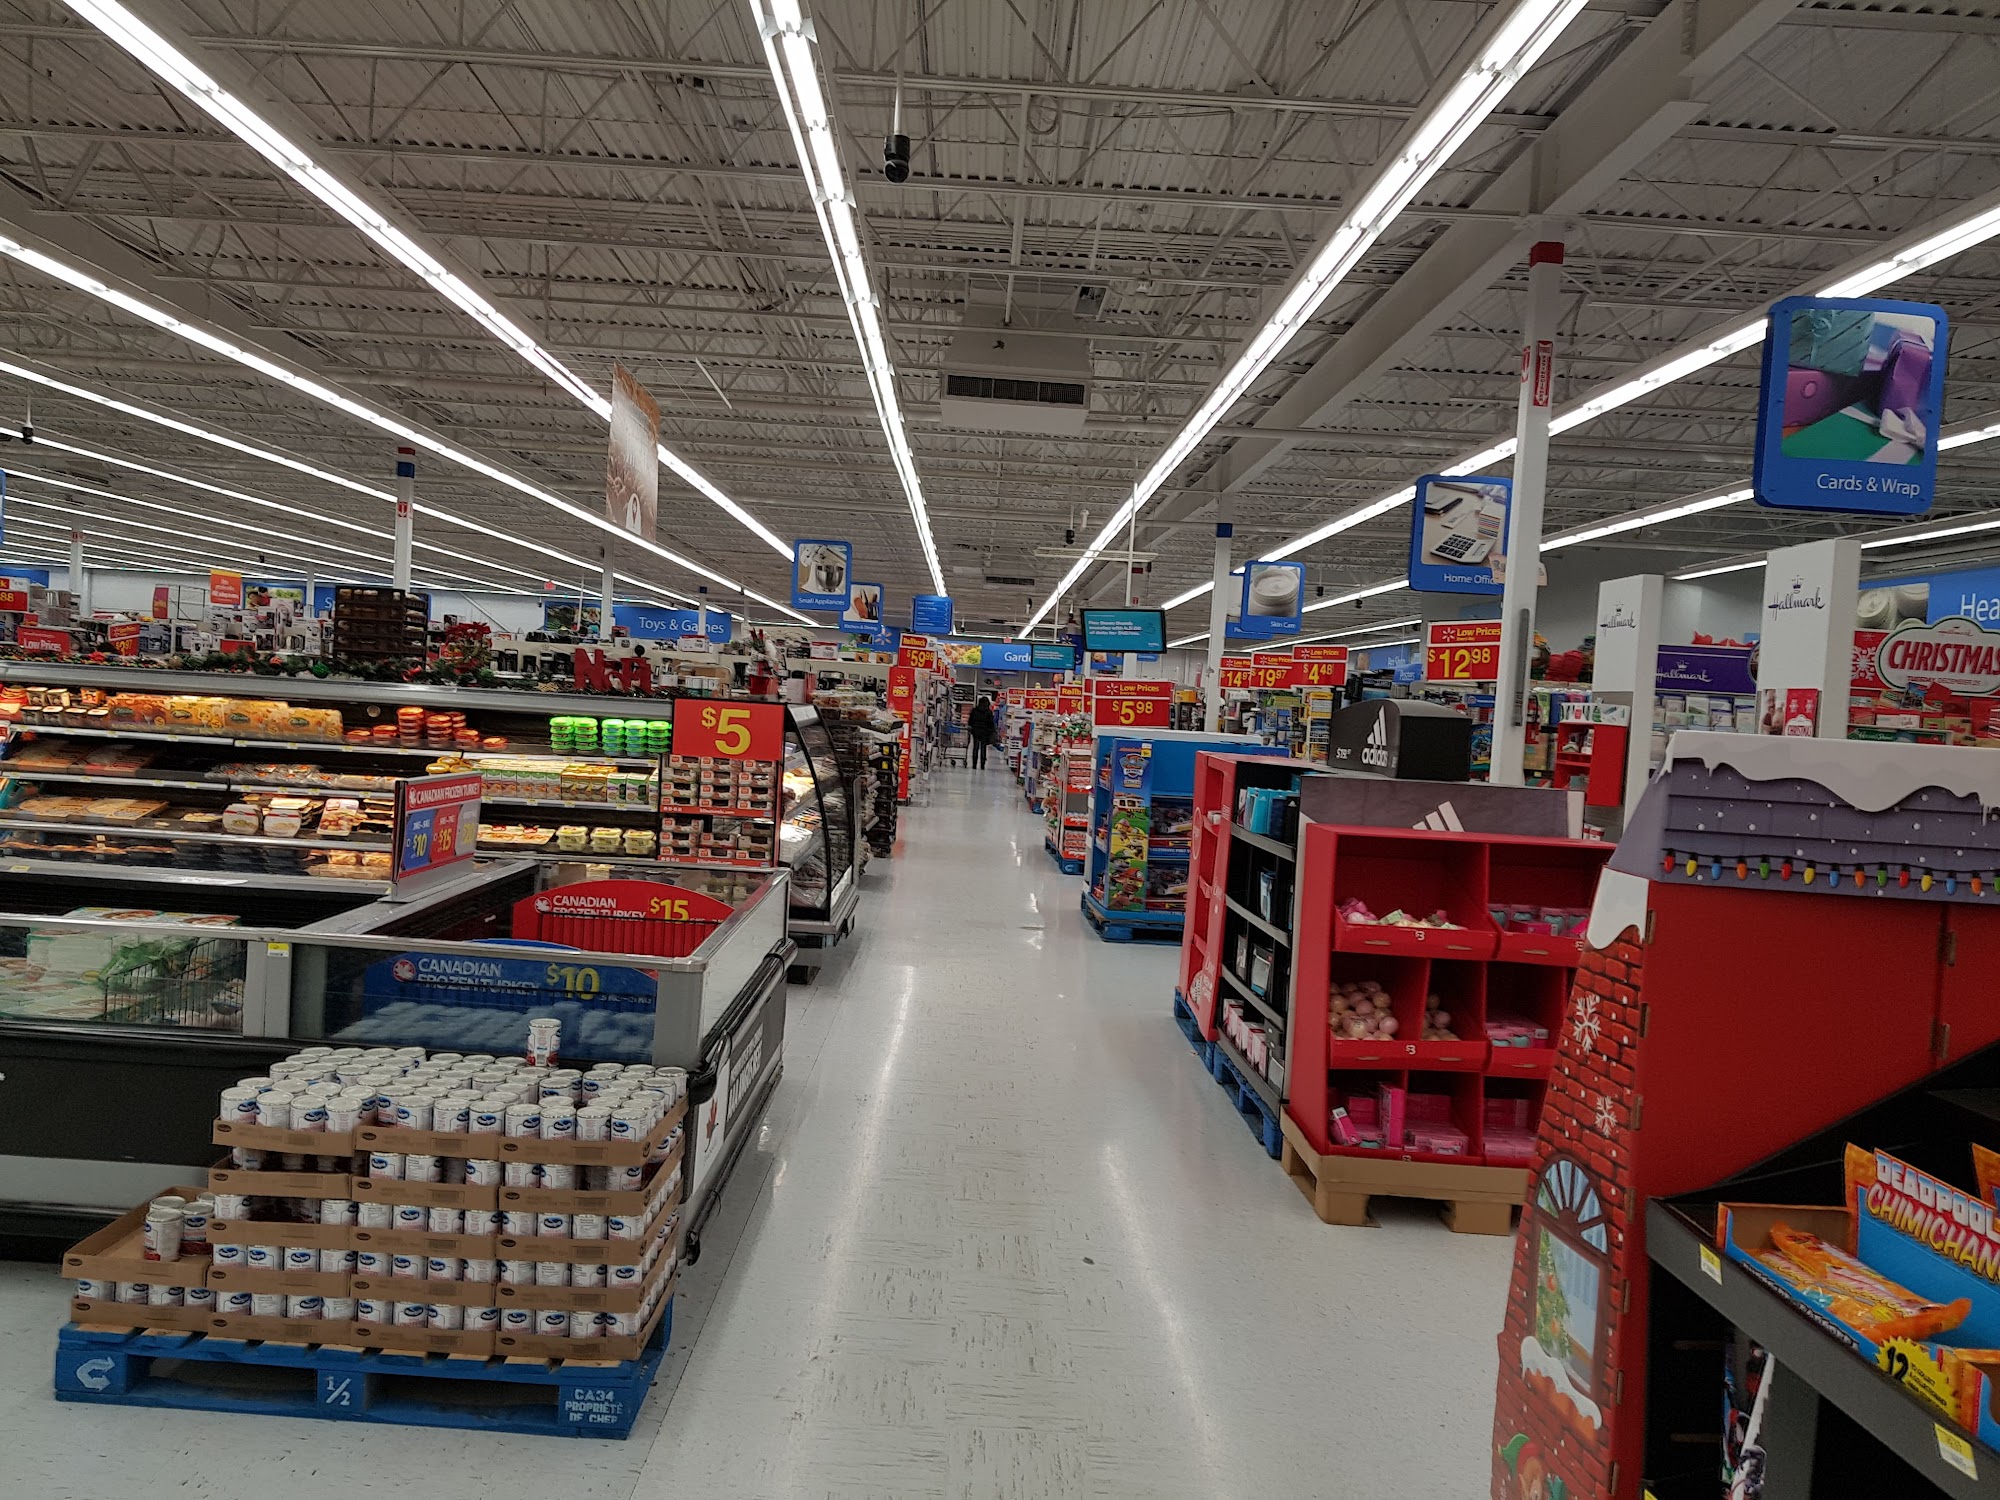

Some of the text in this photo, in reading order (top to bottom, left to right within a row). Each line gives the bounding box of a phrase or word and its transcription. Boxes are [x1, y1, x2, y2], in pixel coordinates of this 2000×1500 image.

[1817, 473, 1920, 498] Cards & Wrap
[1444, 573, 1472, 583] Home
[799, 597, 845, 607] Small Appliances
[1767, 587, 1826, 621] Hallmark
[639, 617, 666, 631] Toys
[669, 619, 678, 630] &
[1457, 627, 1501, 637] Low Prices
[1600, 611, 1637, 637] Hallmark
[23, 638, 62, 651] Low Prices
[902, 637, 926, 646] Rollback
[1004, 652, 1031, 662] Gard
[1656, 667, 1713, 684] Hallmark
[1907, 675, 1936, 683] TUESDAY
[1936, 677, 1970, 686] DECEMBER
[1137, 684, 1160, 692] Prices
[701, 706, 751, 755] $5
[1362, 744, 1389, 767] adidas
[416, 783, 479, 804] CANADIAN FROZEN TURKEY
[413, 833, 427, 857] $10
[438, 828, 452, 851] $15
[553, 895, 616, 908] CANADIAN
[650, 896, 689, 925] $15
[553, 907, 646, 922] FROZEN TURKEY
[418, 957, 501, 977] CANADIAN
[417, 974, 541, 997] FROZEN TURKEY
[546, 962, 600, 1000] $10
[1876, 1153, 2000, 1245] DEADPOOL
[1867, 1182, 2000, 1283] CHIMICHAN
[1887, 1346, 1909, 1381] 12
[325, 1376, 351, 1406] 1/2
[574, 1388, 614, 1402] CA34
[565, 1400, 623, 1415] PROPRIÉTÉ
[569, 1412, 618, 1424] DE CHEP
